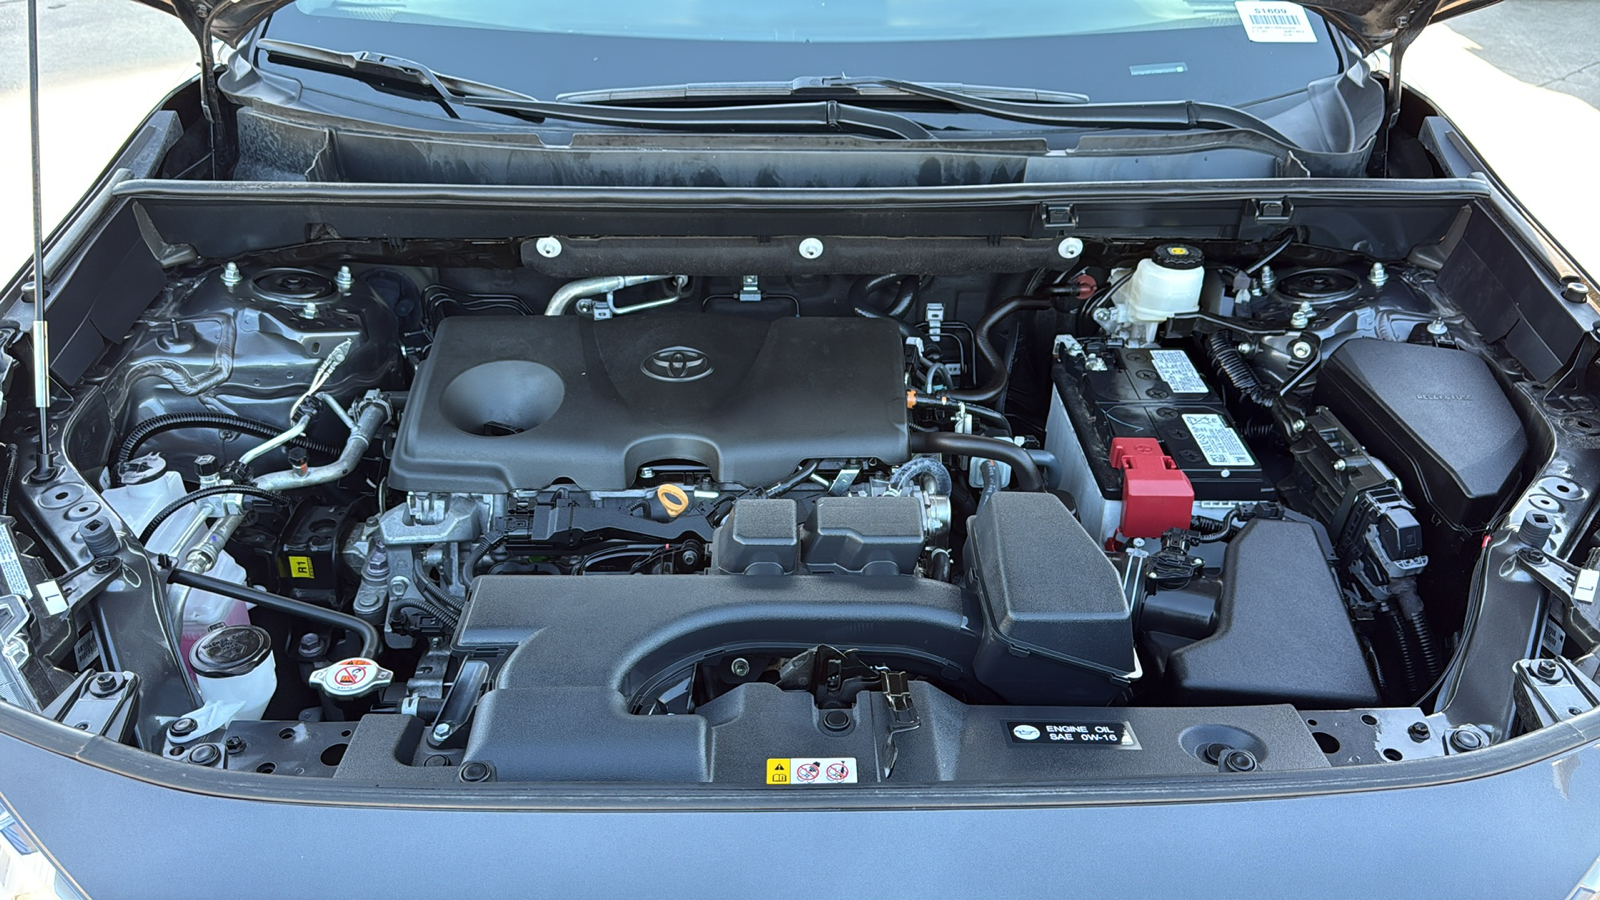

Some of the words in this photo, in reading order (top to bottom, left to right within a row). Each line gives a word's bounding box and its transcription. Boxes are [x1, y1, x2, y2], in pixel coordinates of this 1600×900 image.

[297, 561, 308, 574] R1
[1045, 725, 1088, 733] ENGINE
[1094, 725, 1115, 733] OIL
[1049, 733, 1074, 741] SAE
[1081, 733, 1118, 742] 0W-16
